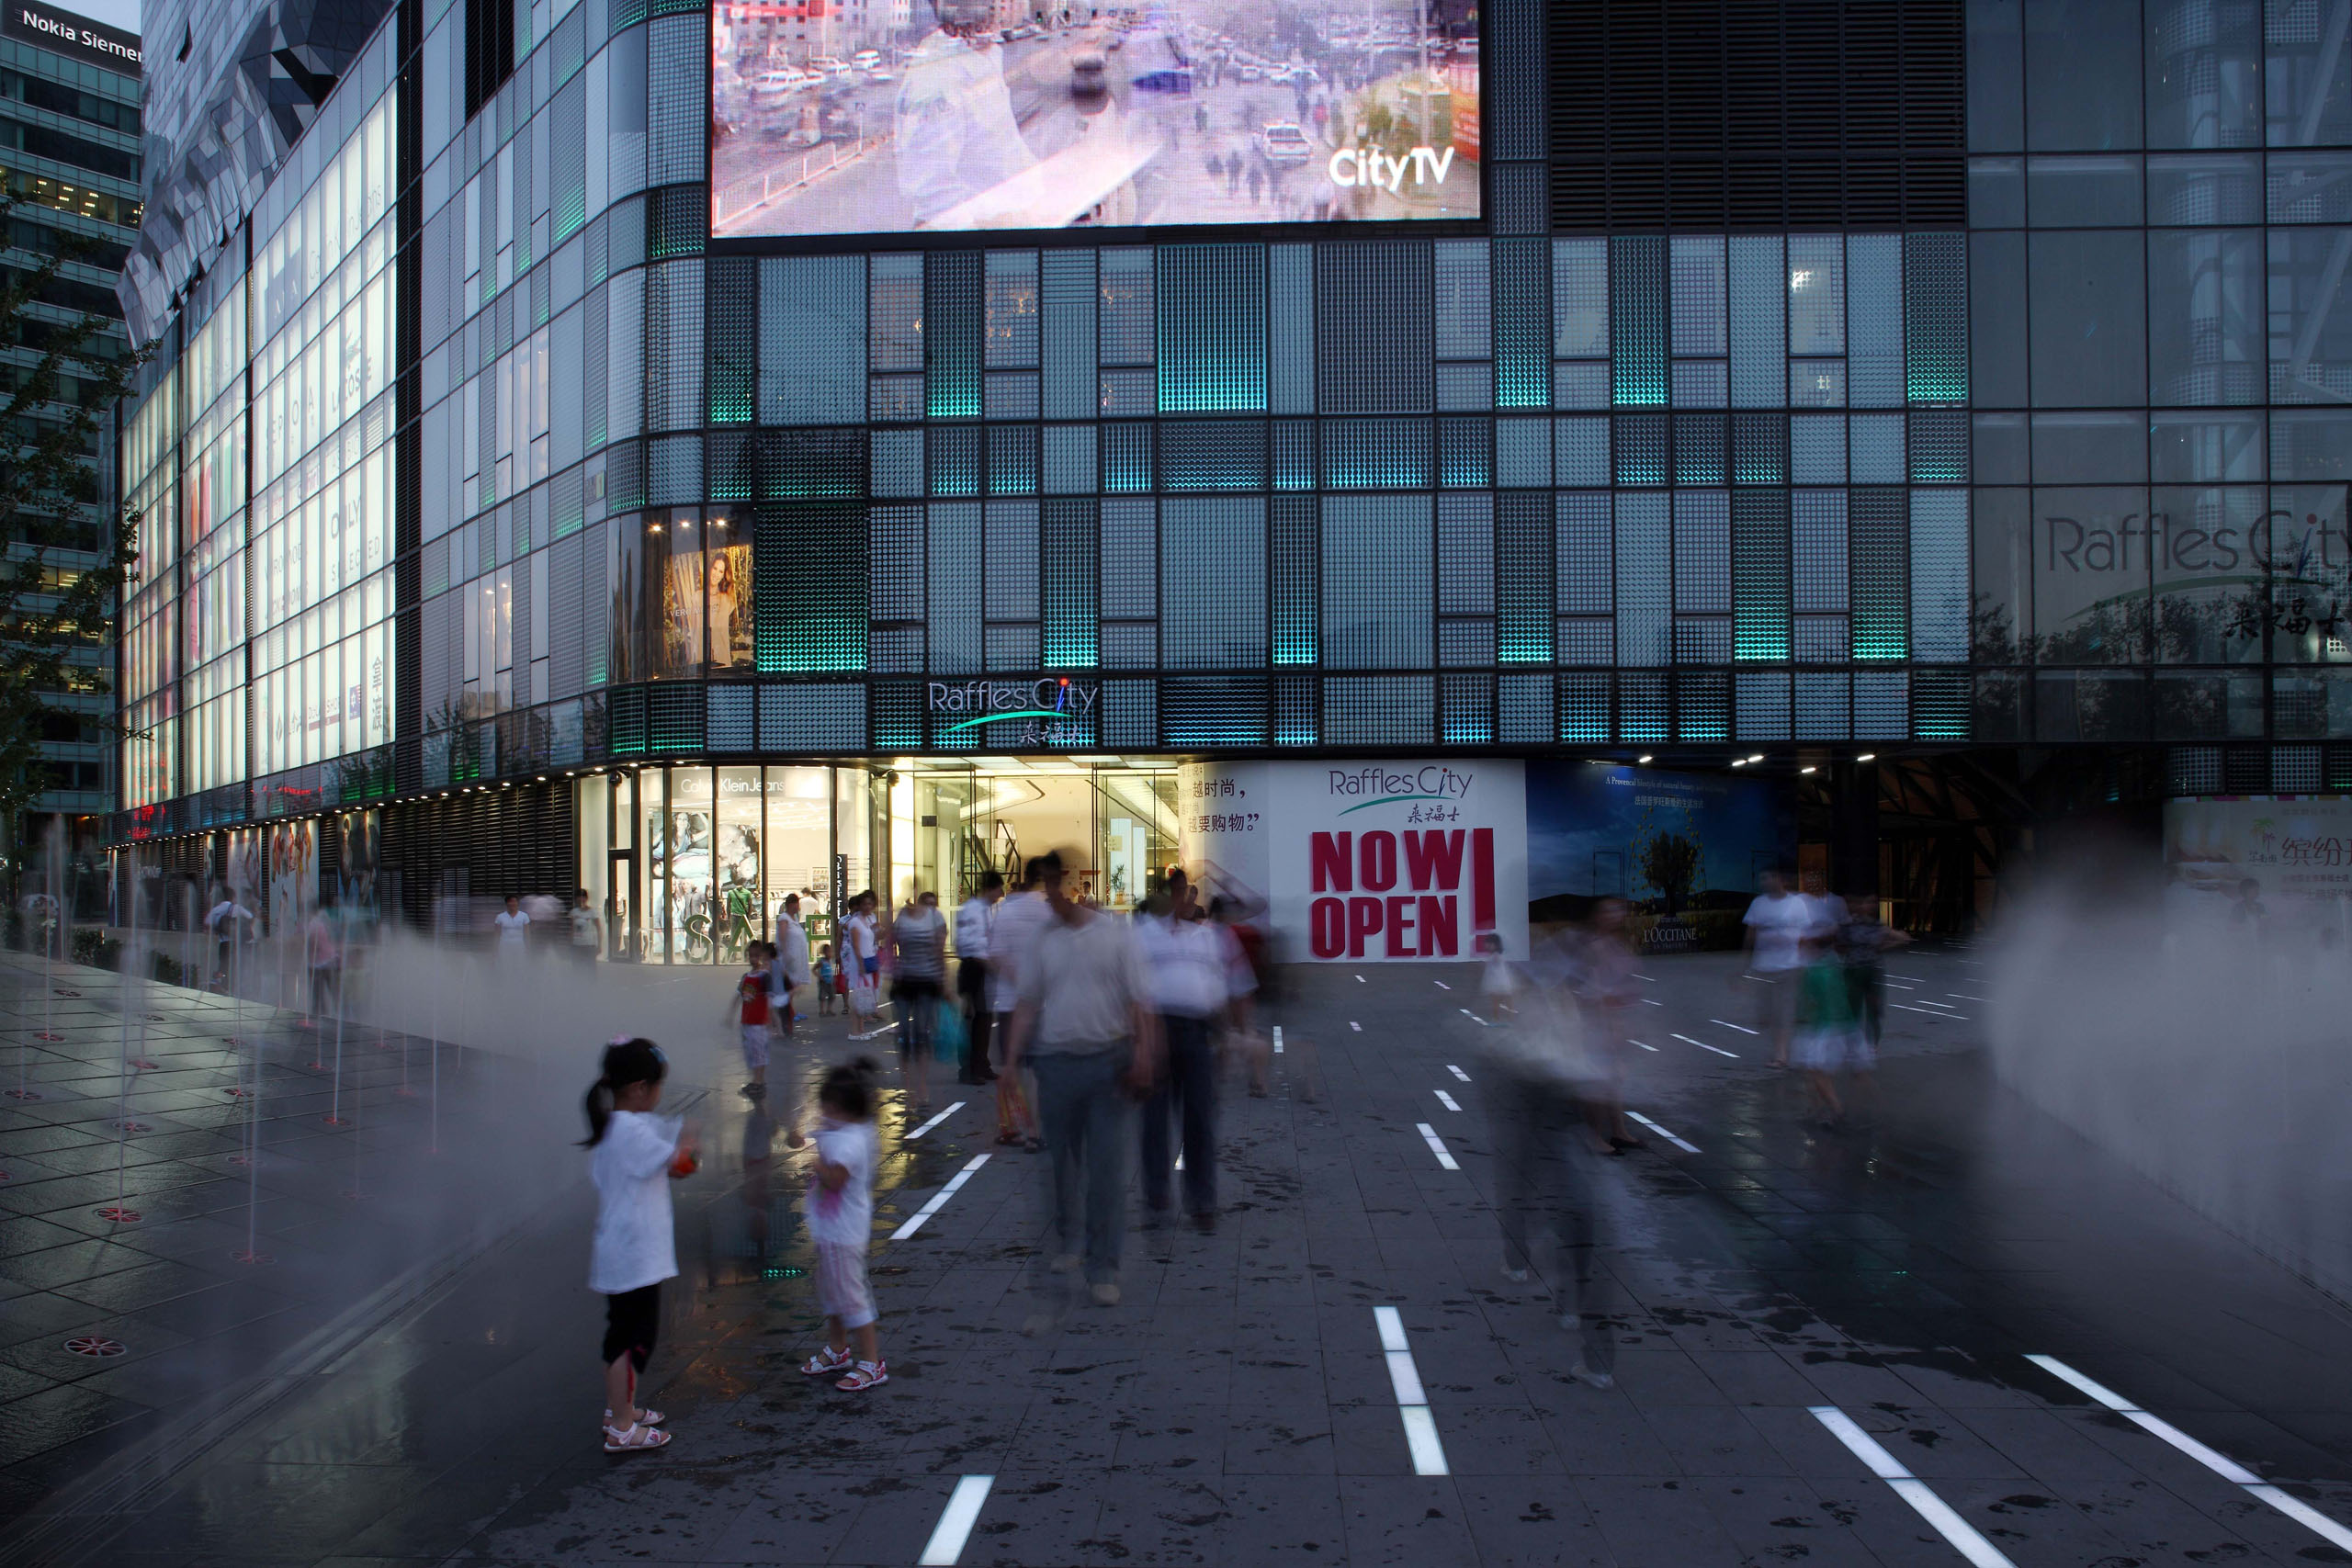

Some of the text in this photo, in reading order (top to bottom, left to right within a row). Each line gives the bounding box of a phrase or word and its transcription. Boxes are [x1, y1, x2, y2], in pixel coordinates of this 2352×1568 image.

[23, 9, 76, 42] Nokia
[1329, 145, 1454, 192] CityTV
[331, 496, 360, 540] OLY
[2045, 513, 2239, 572] Raffles
[928, 678, 1098, 715] Raffles City
[720, 778, 749, 792] Klein
[1329, 765, 1473, 798] Raffles City
[1407, 804, 1460, 825] 来福士
[684, 913, 831, 964] SAE
[1310, 896, 1459, 958] OPEN
[1644, 926, 1697, 942] L'OCCITANE
